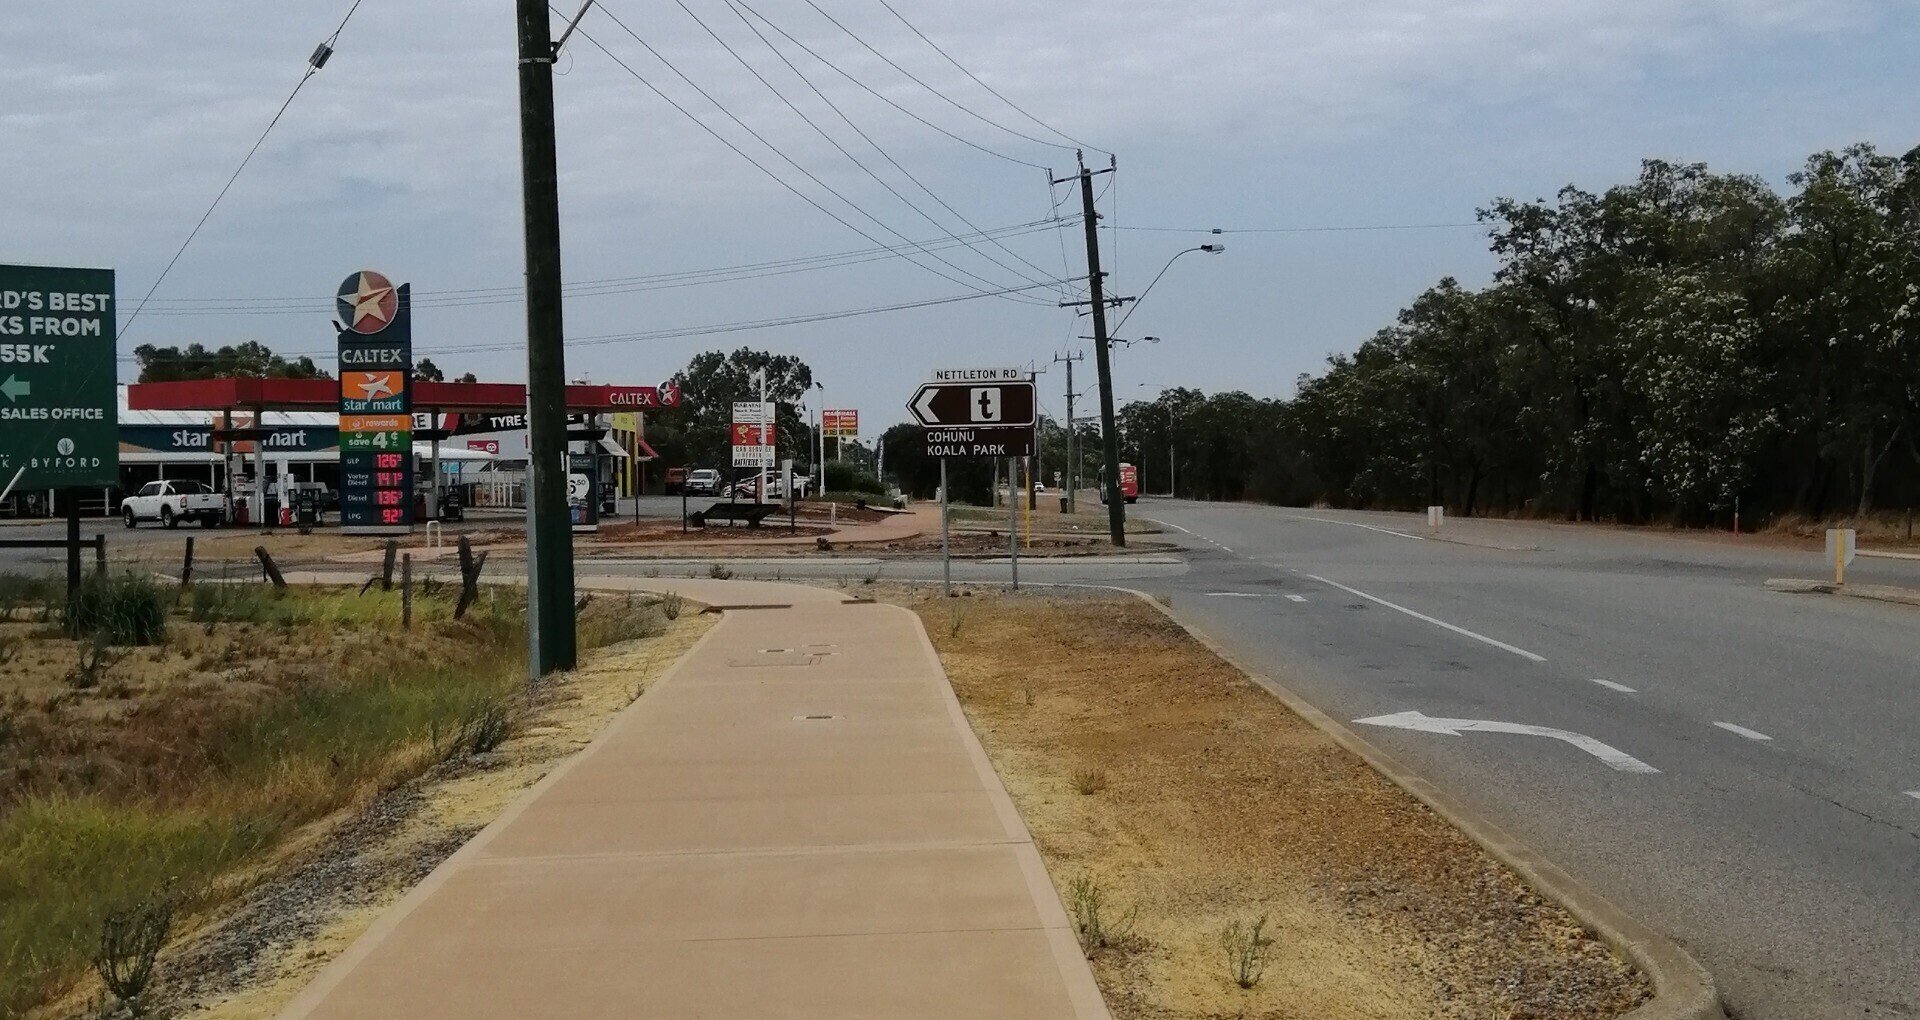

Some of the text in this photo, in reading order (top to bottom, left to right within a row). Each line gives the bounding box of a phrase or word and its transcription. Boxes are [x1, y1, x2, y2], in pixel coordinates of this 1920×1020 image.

[49, 292, 110, 312] BEST
[30, 316, 101, 336] FROM
[341, 348, 403, 364] CALTEX
[936, 369, 1018, 380] NETTLETON RD
[609, 392, 652, 405] CALTEX
[343, 399, 402, 411] star mart
[1, 408, 104, 420] SALES OFFICE
[490, 414, 522, 429] TYRE
[172, 429, 210, 447] star
[348, 438, 370, 446] save
[927, 430, 975, 443] COHUNU
[927, 445, 967, 456] KOALA
[973, 444, 1006, 455] PARK
[31, 457, 100, 468] BYFORD
[347, 494, 368, 502] Diesel
[347, 512, 362, 520] LPG
